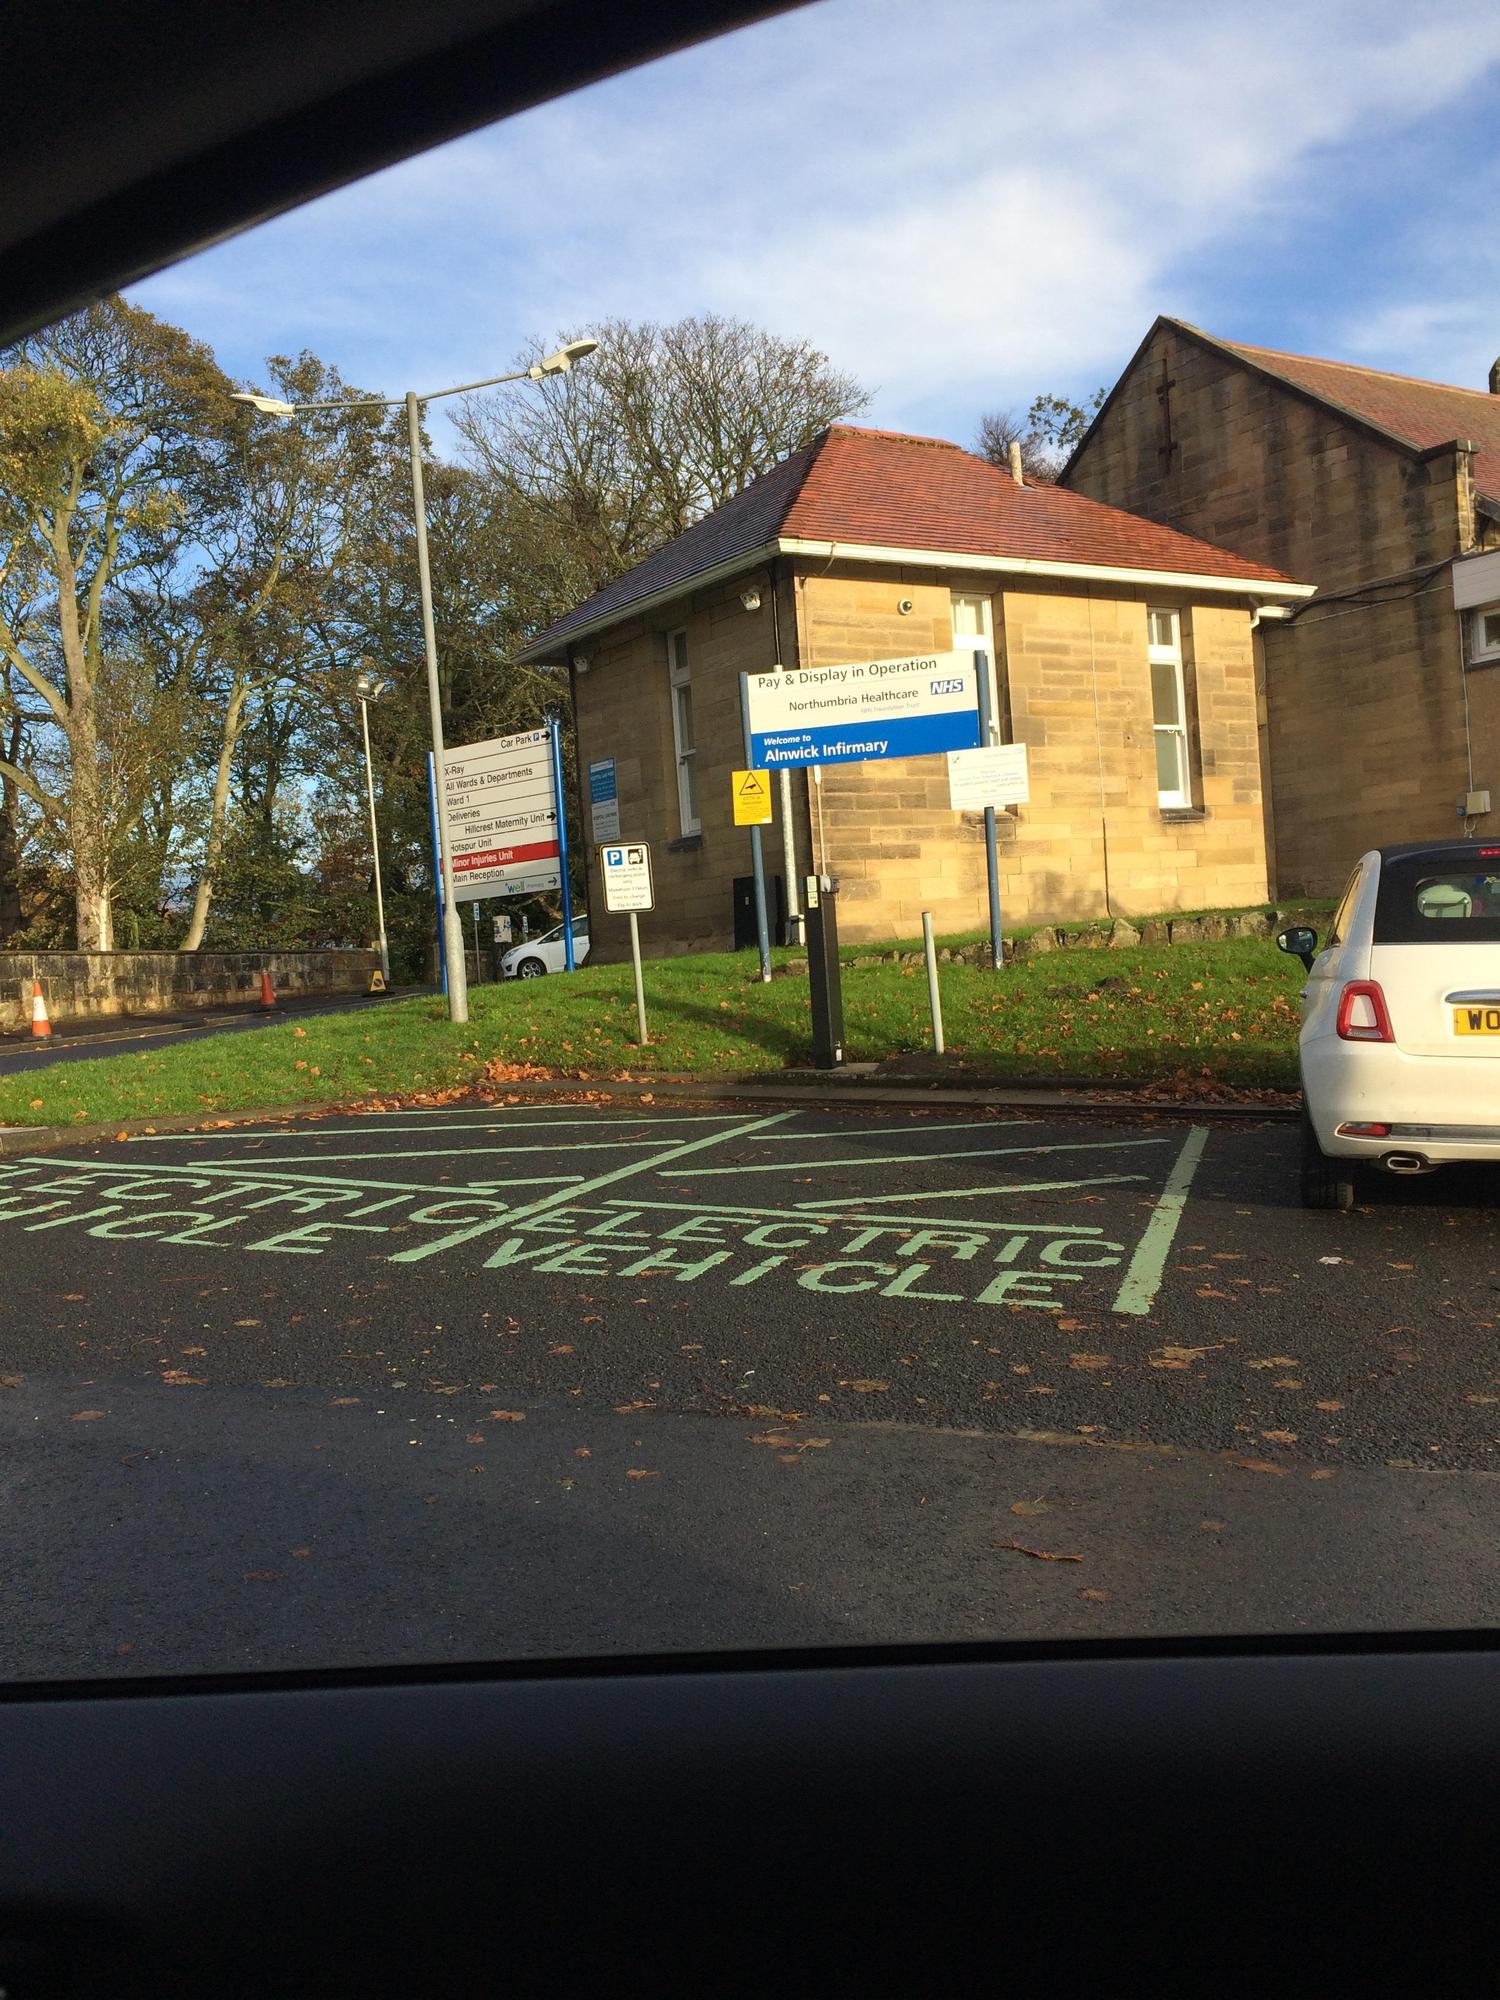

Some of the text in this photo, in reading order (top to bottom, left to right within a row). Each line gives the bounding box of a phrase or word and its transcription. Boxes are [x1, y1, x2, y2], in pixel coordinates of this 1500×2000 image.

[758, 658, 937, 689] Pay & Display in Operation
[931, 679, 964, 695] NHS
[789, 688, 919, 711] Northumbria Healthcare
[500, 739, 513, 749] Car
[515, 734, 532, 746] Park
[763, 734, 811, 746] Welcome to
[765, 739, 888, 762] Alnwick Infirmary
[444, 765, 465, 776] X-Ray
[446, 767, 533, 791] All Wards & Departments
[447, 796, 464, 806] Ward
[448, 808, 481, 822] Deliveries
[464, 813, 545, 835] Hillcrest Maternity Unit
[478, 839, 492, 849] Unit
[471, 853, 497, 866] Injuries
[498, 849, 514, 861] Unit
[469, 868, 505, 882] Reception
[511, 1208, 1126, 1268] ELECTRIC
[482, 1237, 1084, 1310] VEHICLE
